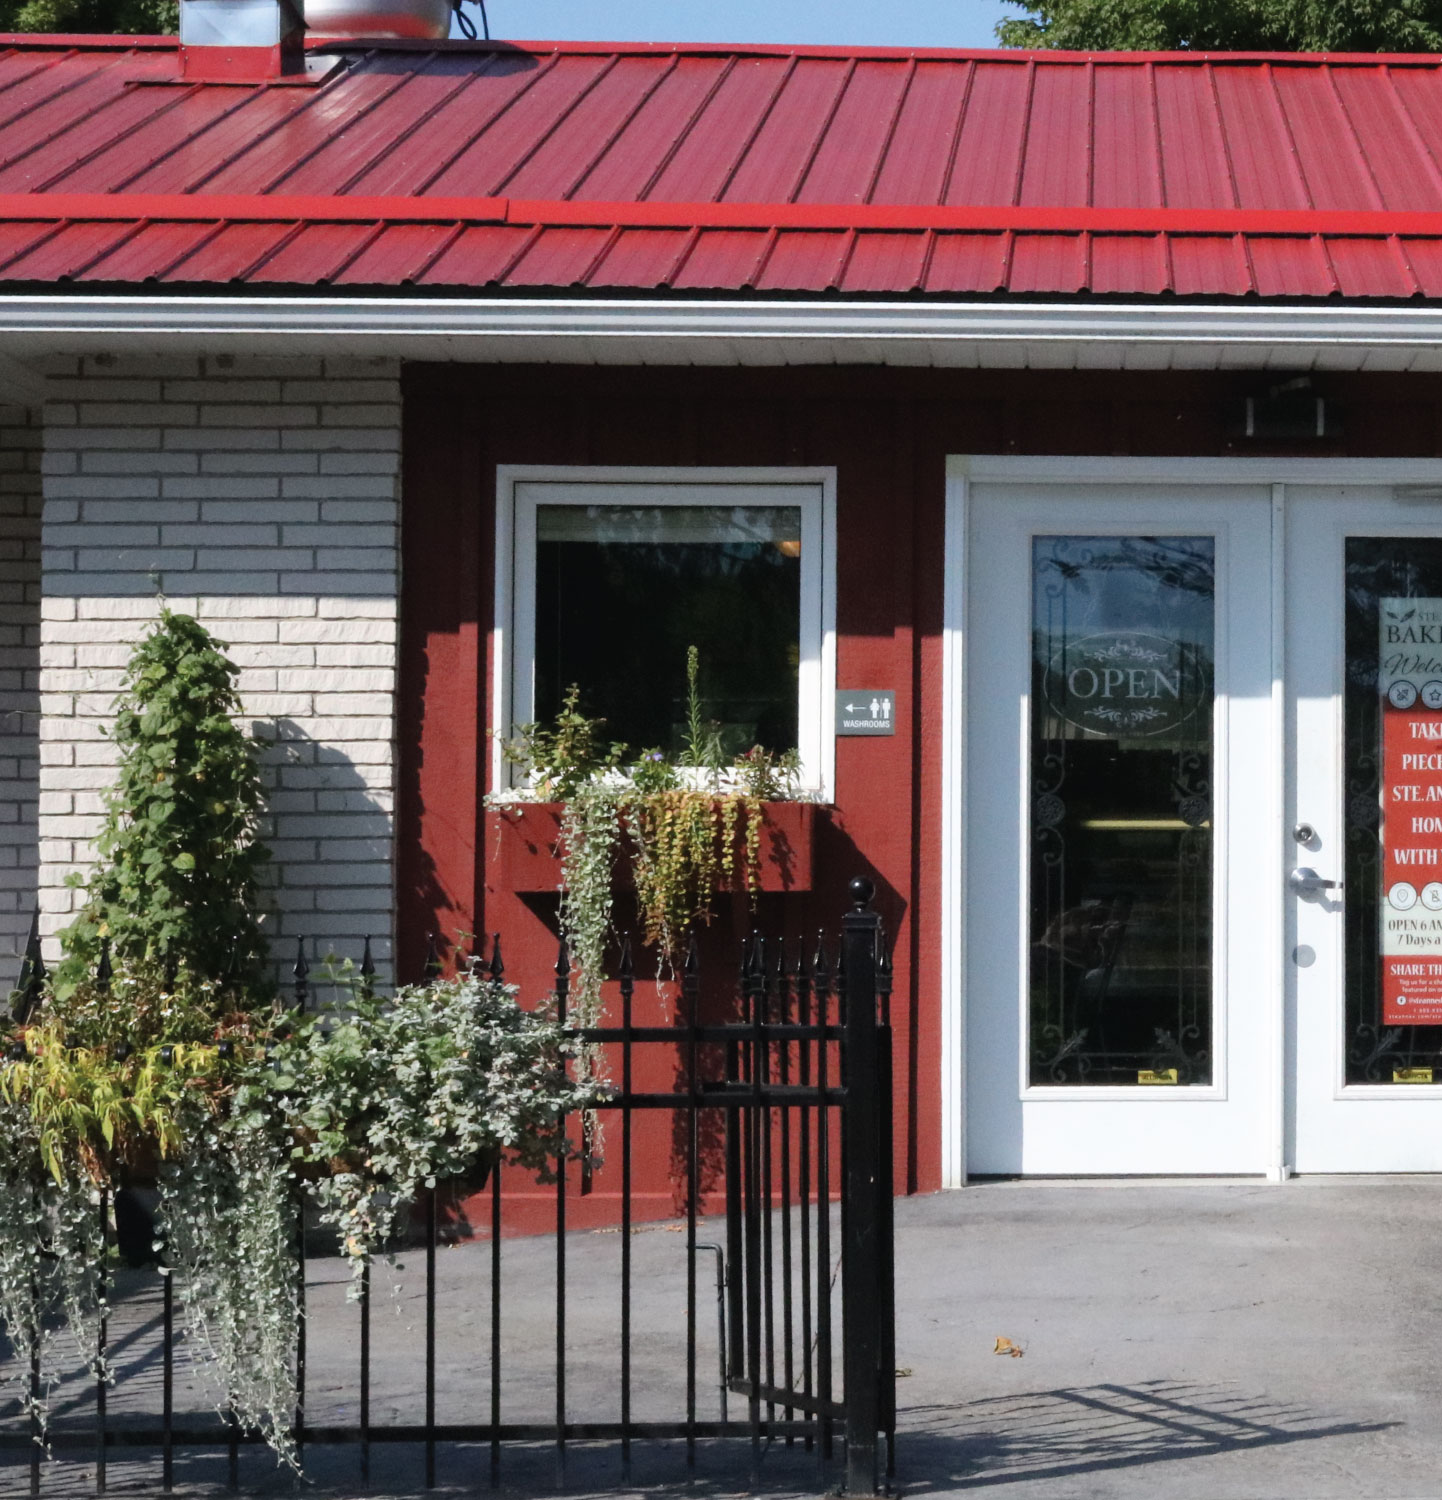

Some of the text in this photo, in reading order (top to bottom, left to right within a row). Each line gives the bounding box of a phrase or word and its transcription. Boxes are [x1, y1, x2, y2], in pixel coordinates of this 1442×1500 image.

[1068, 667, 1181, 699] OPEN
[842, 720, 890, 728] WASHROOMS
[1392, 785, 1425, 802] STE.
[1393, 849, 1438, 865] WITH
[1388, 919, 1417, 931] OPEN
[1420, 919, 1427, 931] 6
[1397, 934, 1404, 945] 7
[1406, 934, 1432, 948] Days
[1434, 937, 1441, 945] a
[1390, 964, 1426, 976] SHARE
